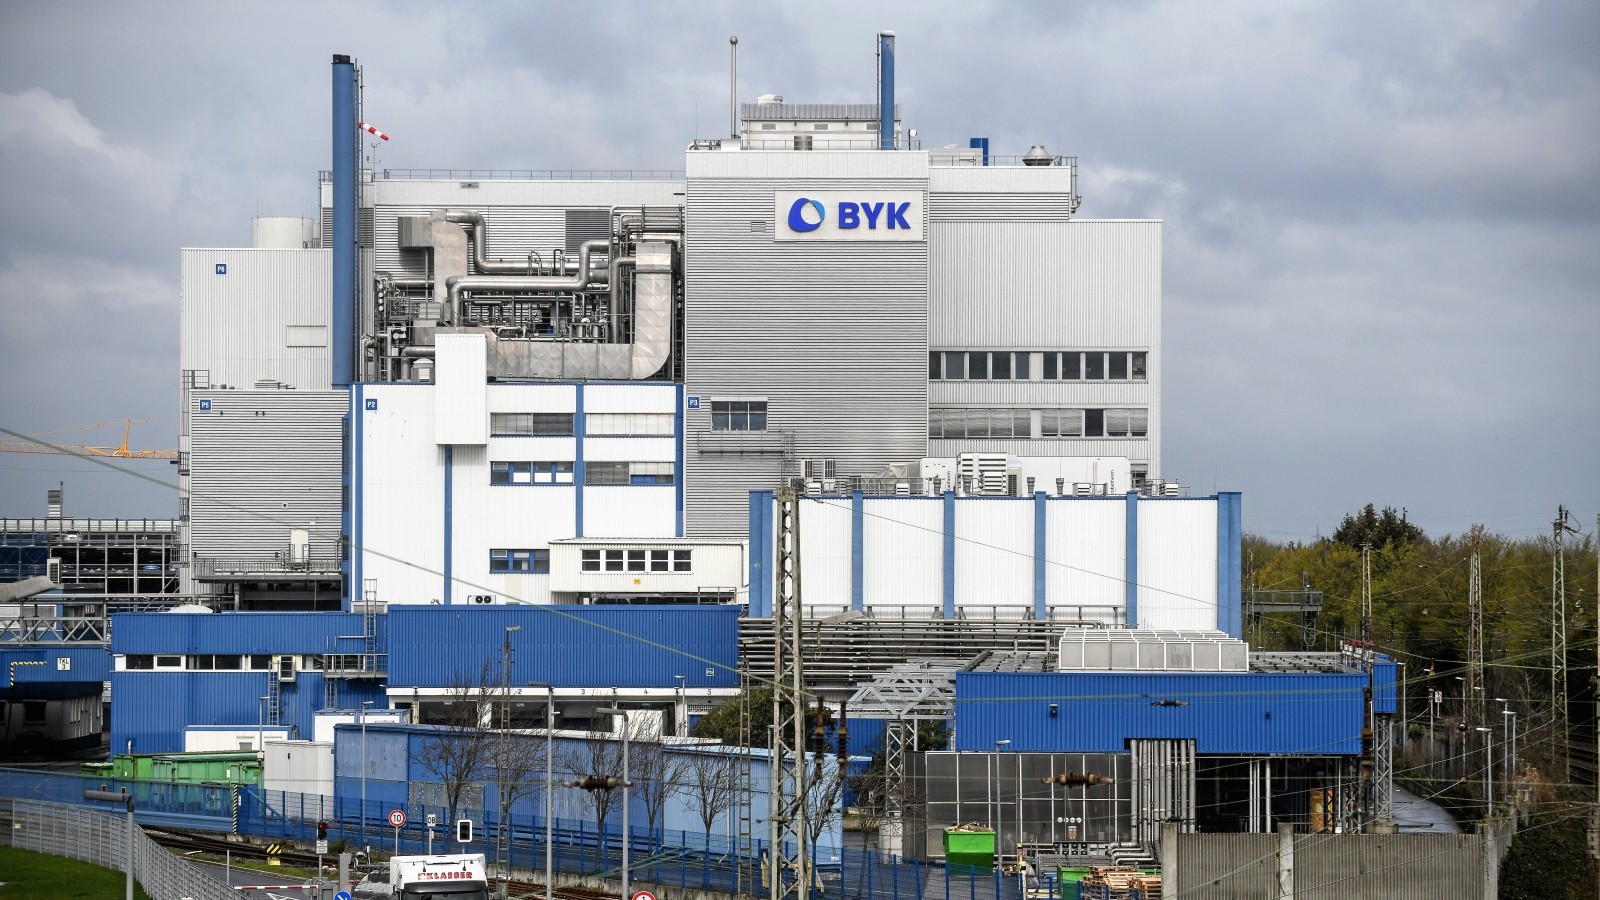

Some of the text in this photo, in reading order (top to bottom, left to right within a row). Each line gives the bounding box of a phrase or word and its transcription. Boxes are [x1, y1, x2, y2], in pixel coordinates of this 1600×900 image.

[838, 202, 911, 229] BYK
[201, 401, 210, 409] P5
[393, 814, 402, 822] 10
